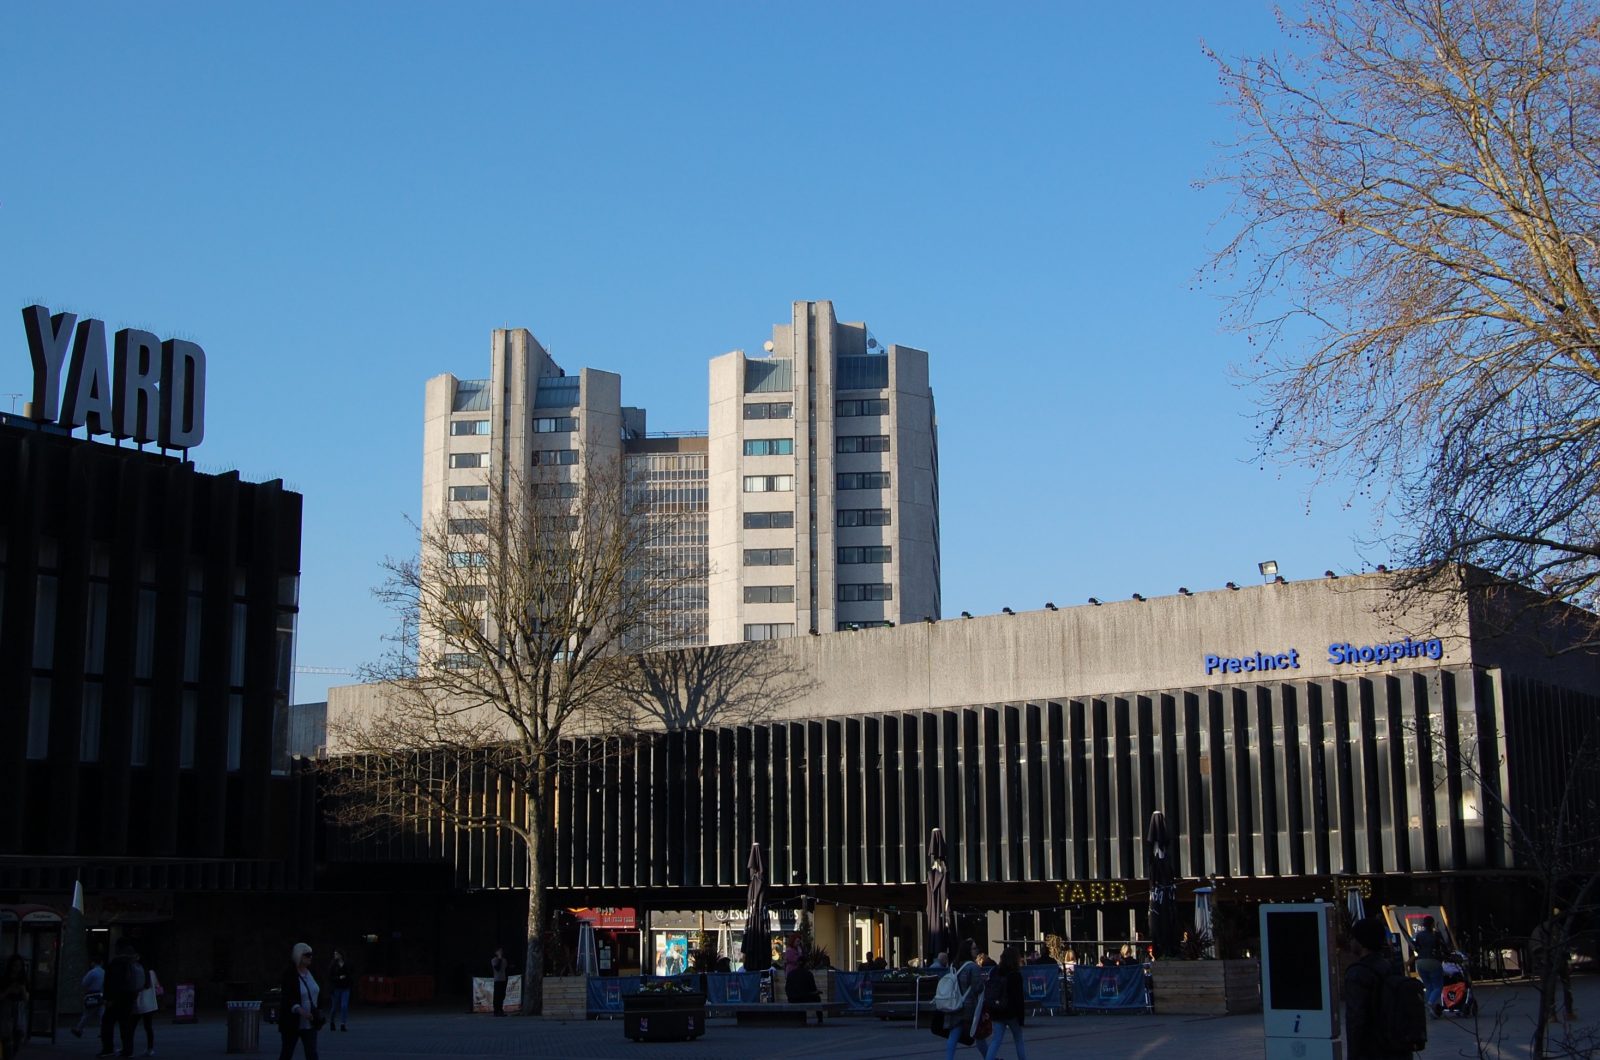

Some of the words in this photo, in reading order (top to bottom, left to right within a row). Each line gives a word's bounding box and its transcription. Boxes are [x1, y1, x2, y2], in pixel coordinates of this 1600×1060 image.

[22, 304, 206, 449] YARD
[1205, 647, 1300, 675] Precinct
[1328, 636, 1443, 665] Shopping
[1056, 881, 1127, 903] YARD
